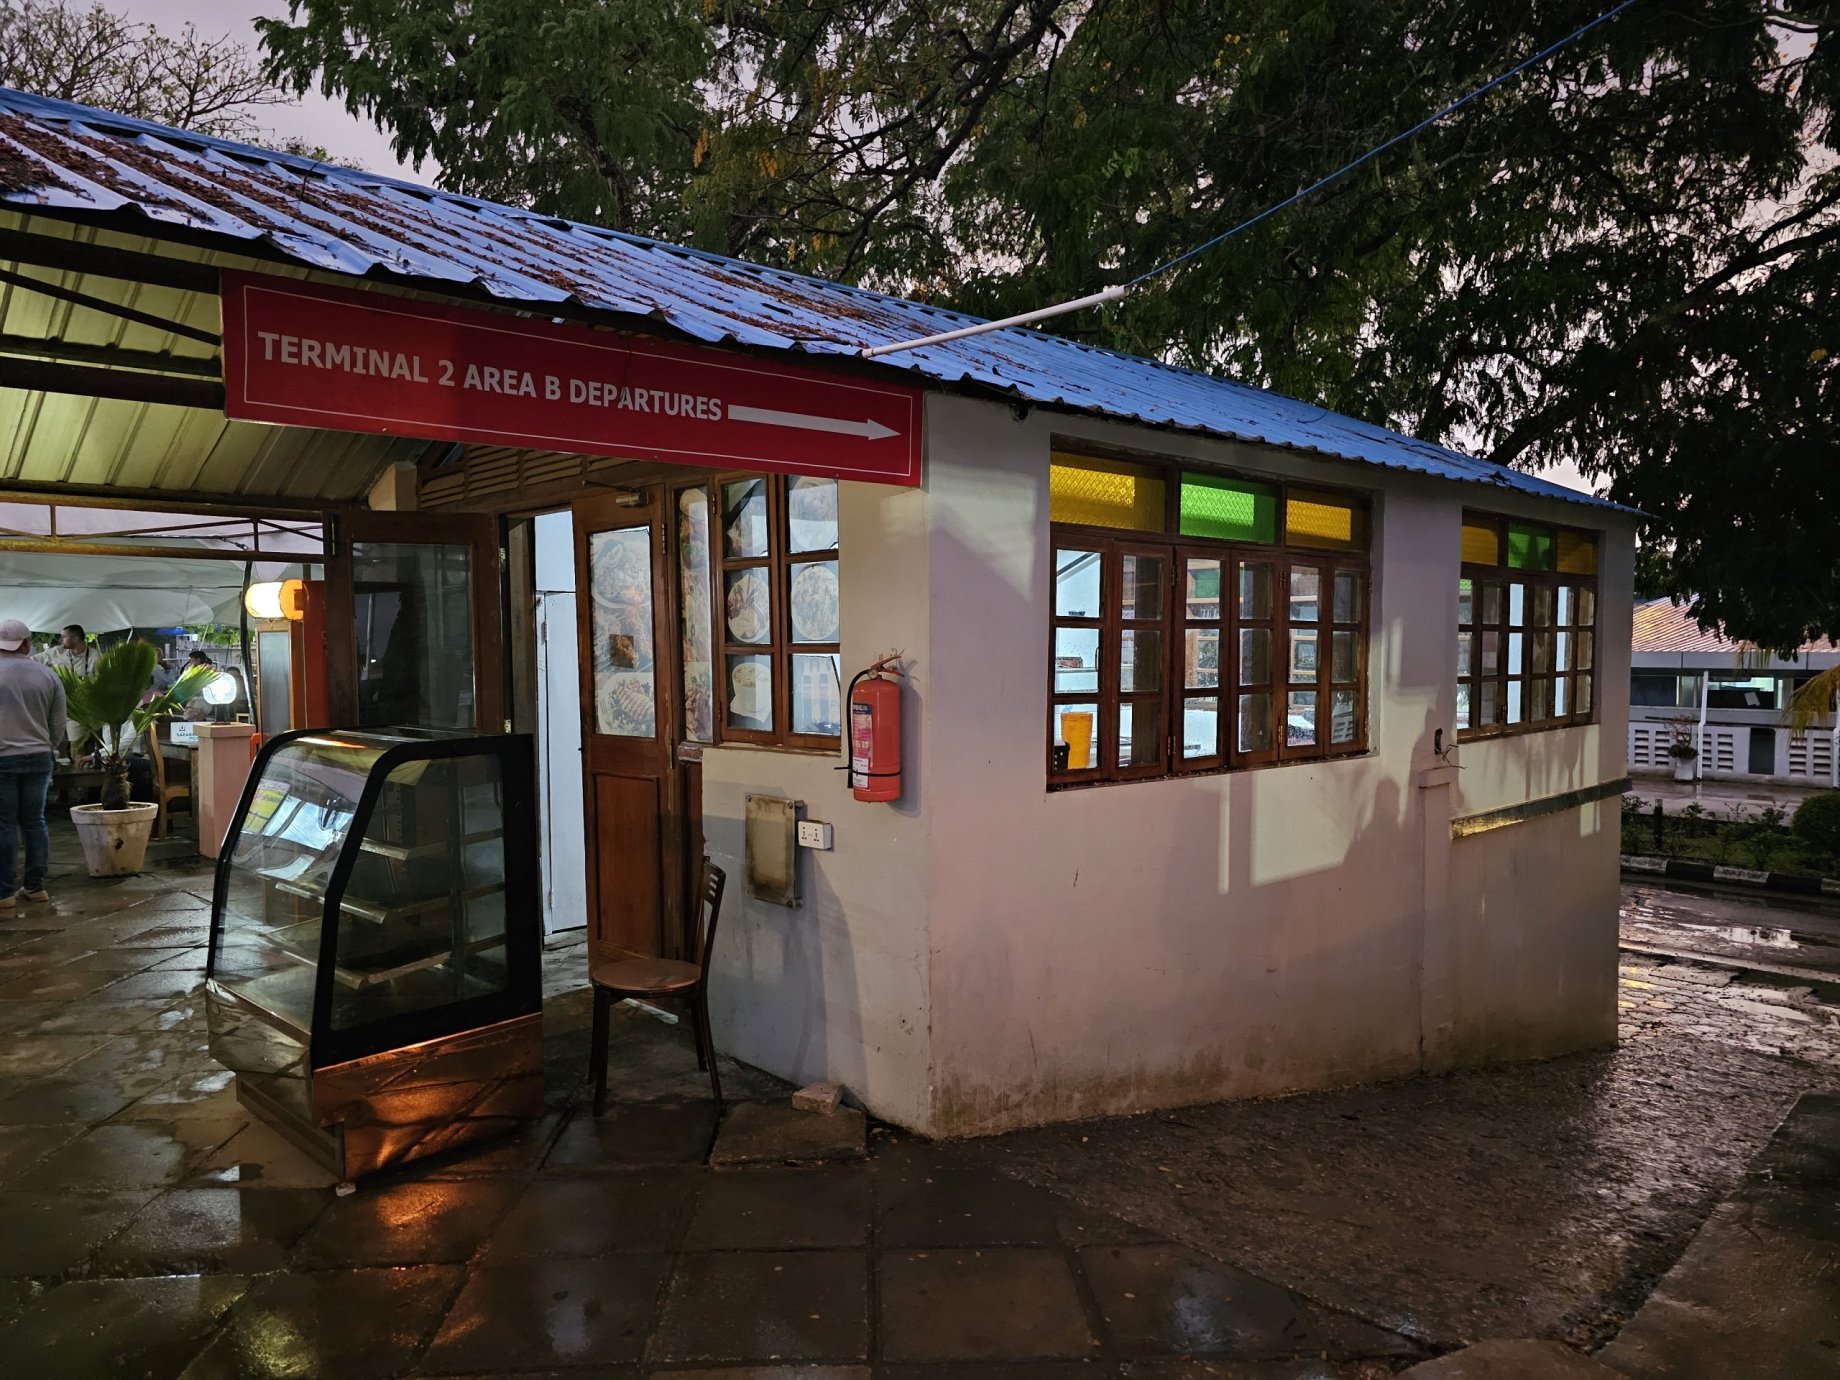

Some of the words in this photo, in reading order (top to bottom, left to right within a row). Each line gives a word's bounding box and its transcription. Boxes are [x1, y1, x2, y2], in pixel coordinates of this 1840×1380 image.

[258, 331, 429, 383] TERMINAL
[438, 360, 455, 386] 2
[463, 365, 537, 398] AREA
[545, 375, 561, 400] B
[570, 379, 722, 421] DEPARTURES
